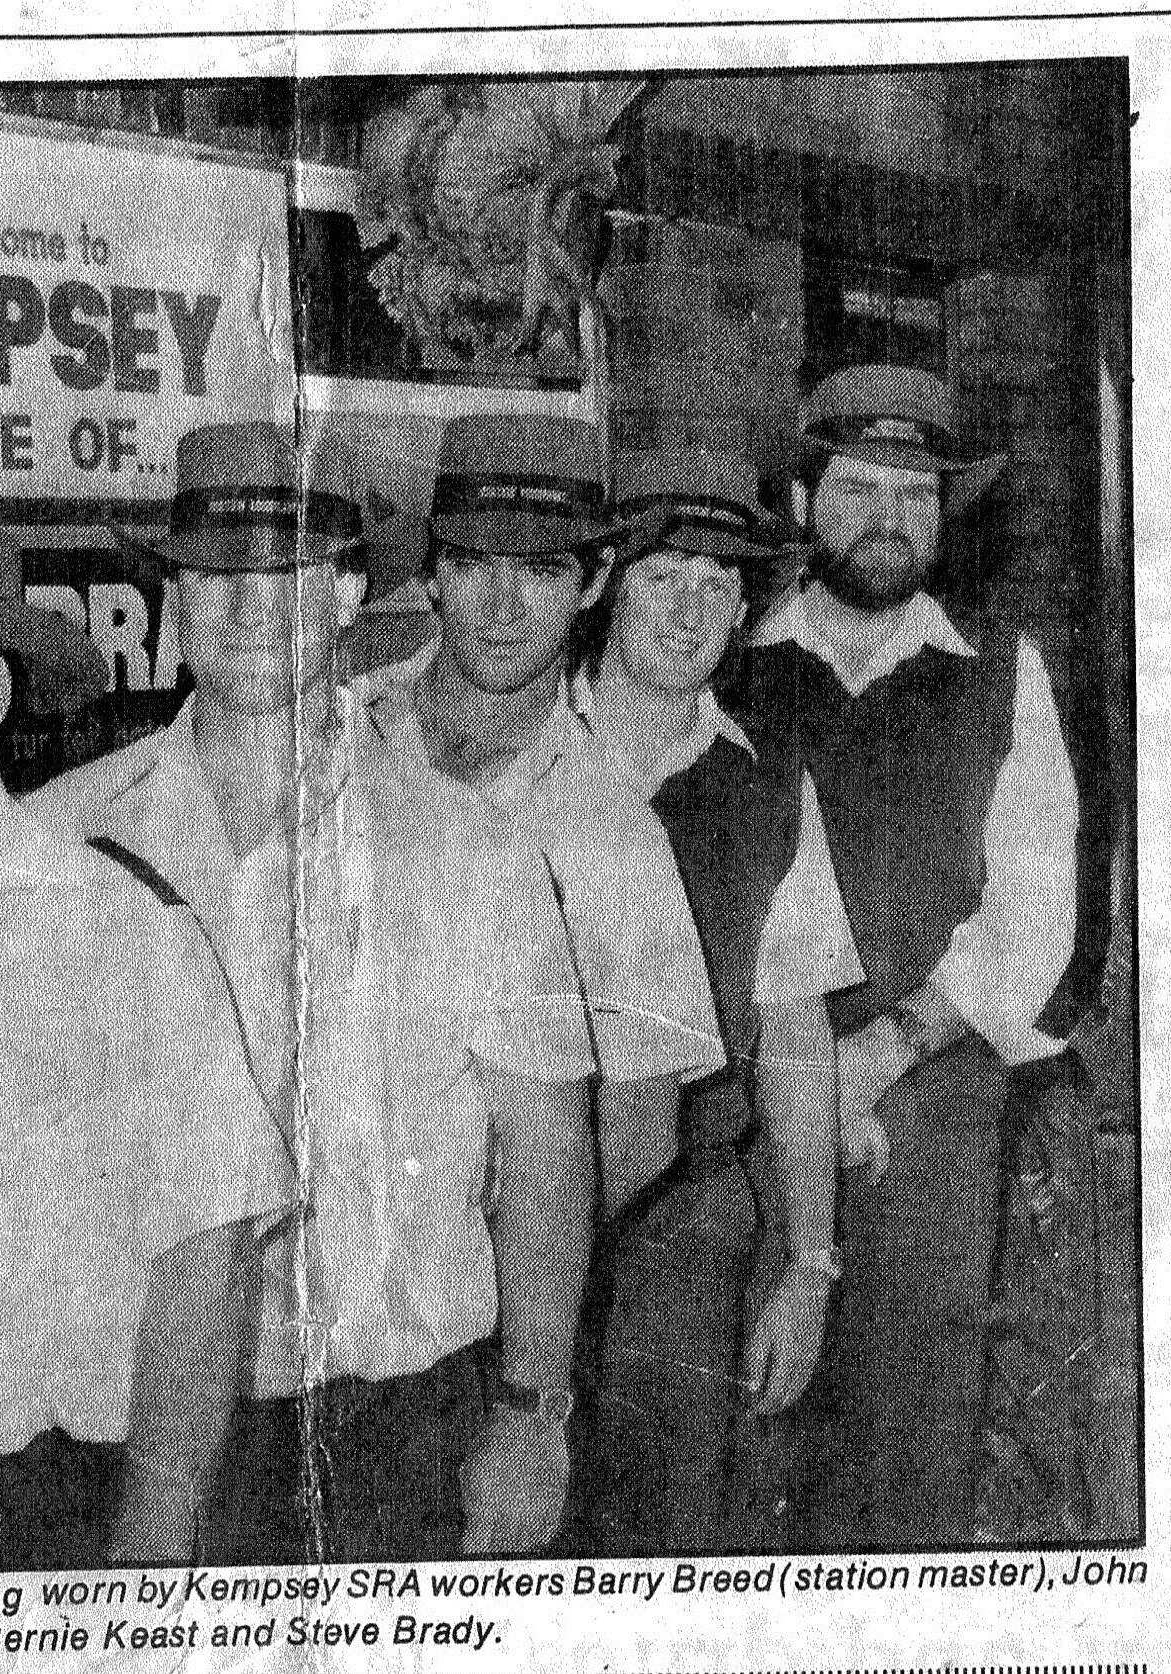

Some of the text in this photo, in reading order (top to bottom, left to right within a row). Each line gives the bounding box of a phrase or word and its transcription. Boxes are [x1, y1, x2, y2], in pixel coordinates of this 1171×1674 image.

[78, 222, 111, 266] to
[67, 417, 170, 474] OF...
[42, 1581, 128, 1605] worn
[137, 1574, 178, 1609] by
[184, 1571, 341, 1606] Kempsey
[347, 1569, 421, 1598] SRA
[432, 1568, 565, 1597] workers
[573, 1566, 665, 1601] Barry
[673, 1563, 776, 1593] Breed
[780, 1563, 910, 1596] (station
[918, 1558, 1055, 1592] master),
[1062, 1556, 1148, 1585] John
[103, 1621, 199, 1649] Keast
[211, 1619, 276, 1647] and
[287, 1616, 380, 1646] Steve
[393, 1615, 504, 1650] Brady.
